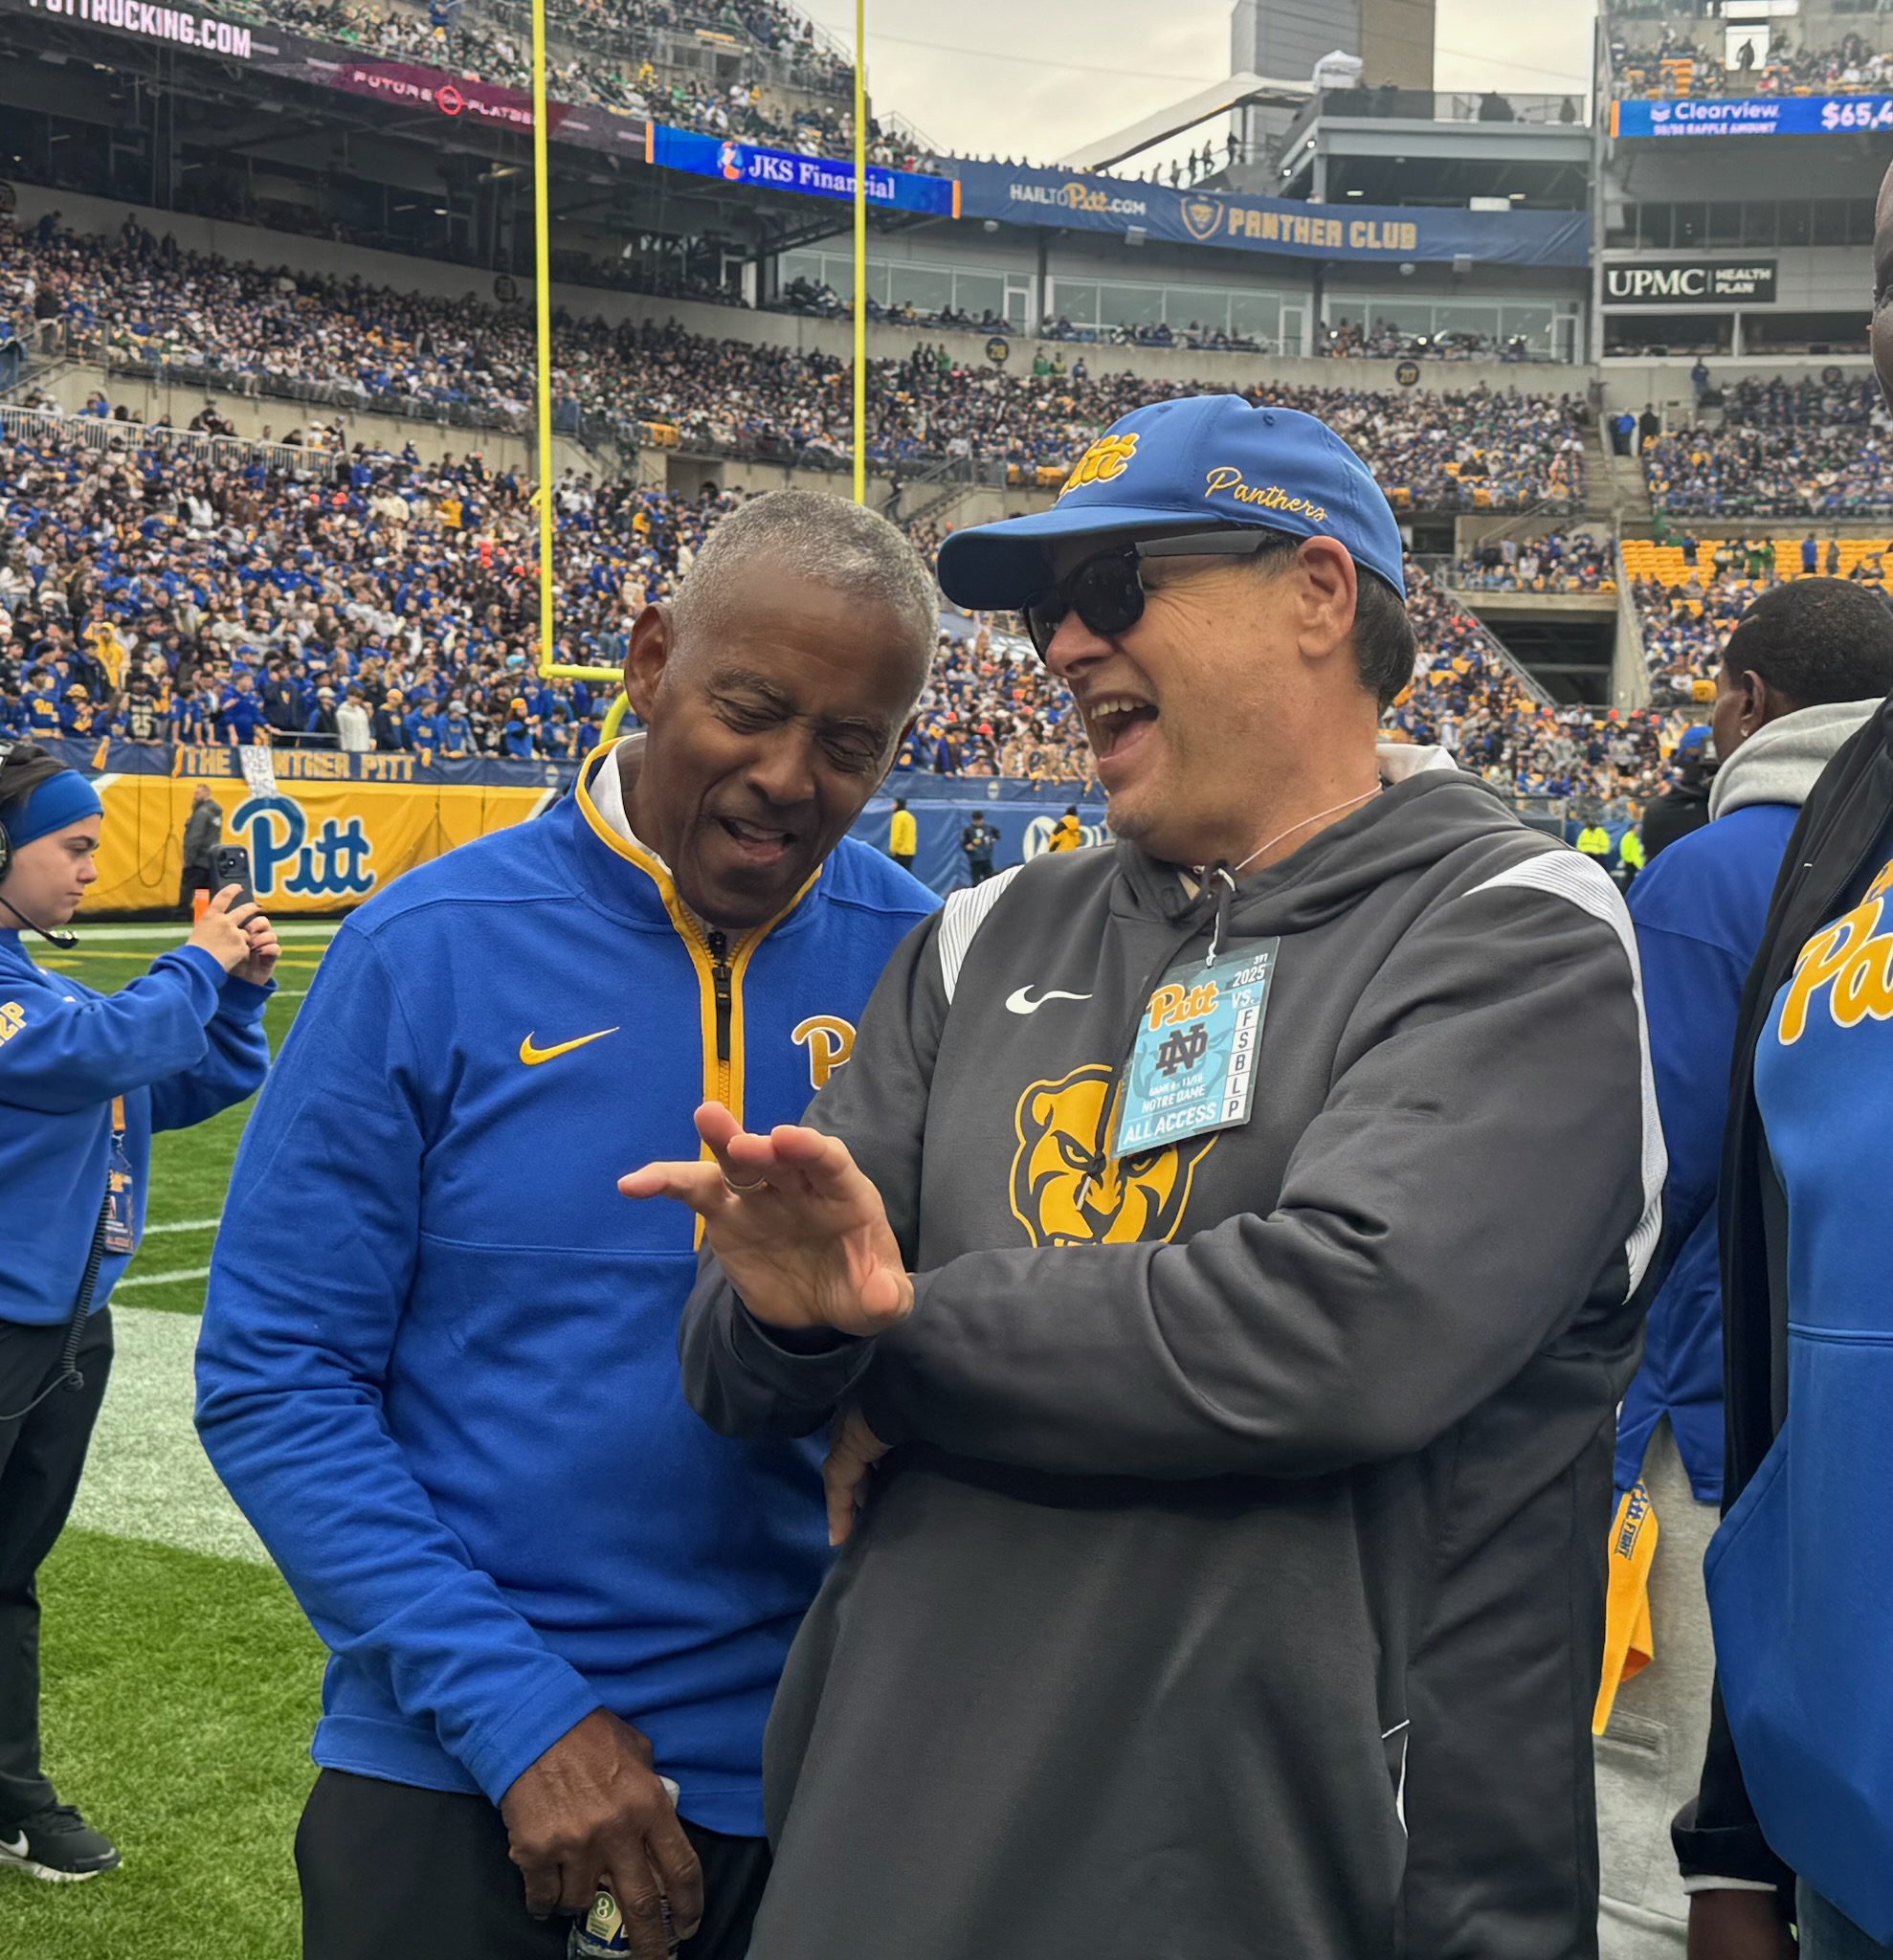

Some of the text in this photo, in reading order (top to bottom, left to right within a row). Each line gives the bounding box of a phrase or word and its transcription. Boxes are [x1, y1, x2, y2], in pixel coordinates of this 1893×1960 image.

[29, 0, 251, 59] TTRUCKING.COM
[1675, 101, 1779, 120] Clearview
[748, 155, 895, 199] JKS Finanial
[1228, 208, 1416, 250] PANTHER CLUB
[1608, 268, 1705, 297] UPMC
[1715, 268, 1771, 280] HEALTH
[1715, 281, 1754, 294] PLAN
[1205, 466, 1329, 523] Panthers
[187, 746, 232, 775] THE
[273, 749, 350, 778] NTHER
[360, 754, 415, 781] PITT
[231, 795, 376, 897] Pitt
[1232, 964, 1266, 988] 2025
[1147, 980, 1219, 1031] Pitt
[1232, 990, 1255, 1009] VS.
[1243, 1011, 1253, 1027] F
[791, 1014, 857, 1090] P
[1238, 1033, 1249, 1049] S
[1235, 1055, 1245, 1072] B
[1141, 1084, 1206, 1114] NOTRE DAME
[1232, 1078, 1240, 1094] L
[1123, 1102, 1217, 1145] ALL ACCESS
[1229, 1101, 1239, 1118] P
